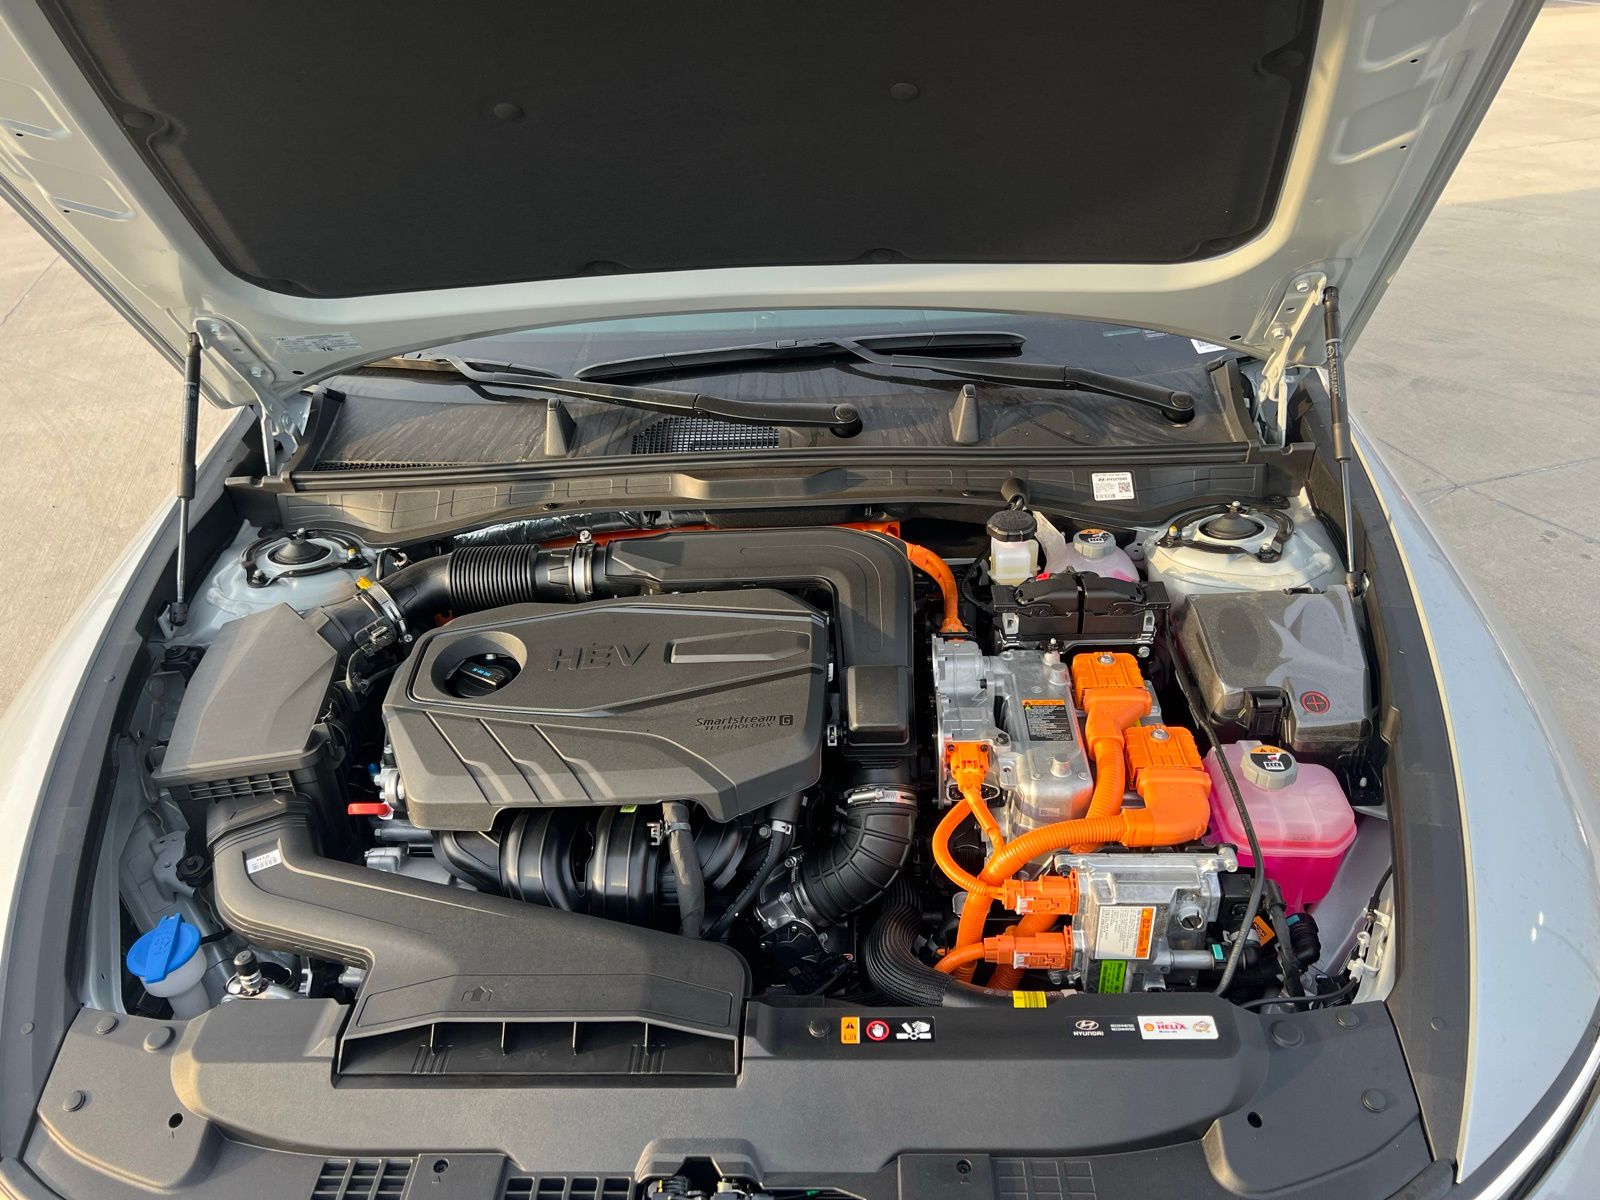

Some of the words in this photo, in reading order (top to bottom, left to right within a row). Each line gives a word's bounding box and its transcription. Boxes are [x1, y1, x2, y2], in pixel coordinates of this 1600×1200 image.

[546, 642, 651, 672] HEV
[695, 715, 776, 726] Smartstream
[705, 722, 773, 731] TECHNOLOGY
